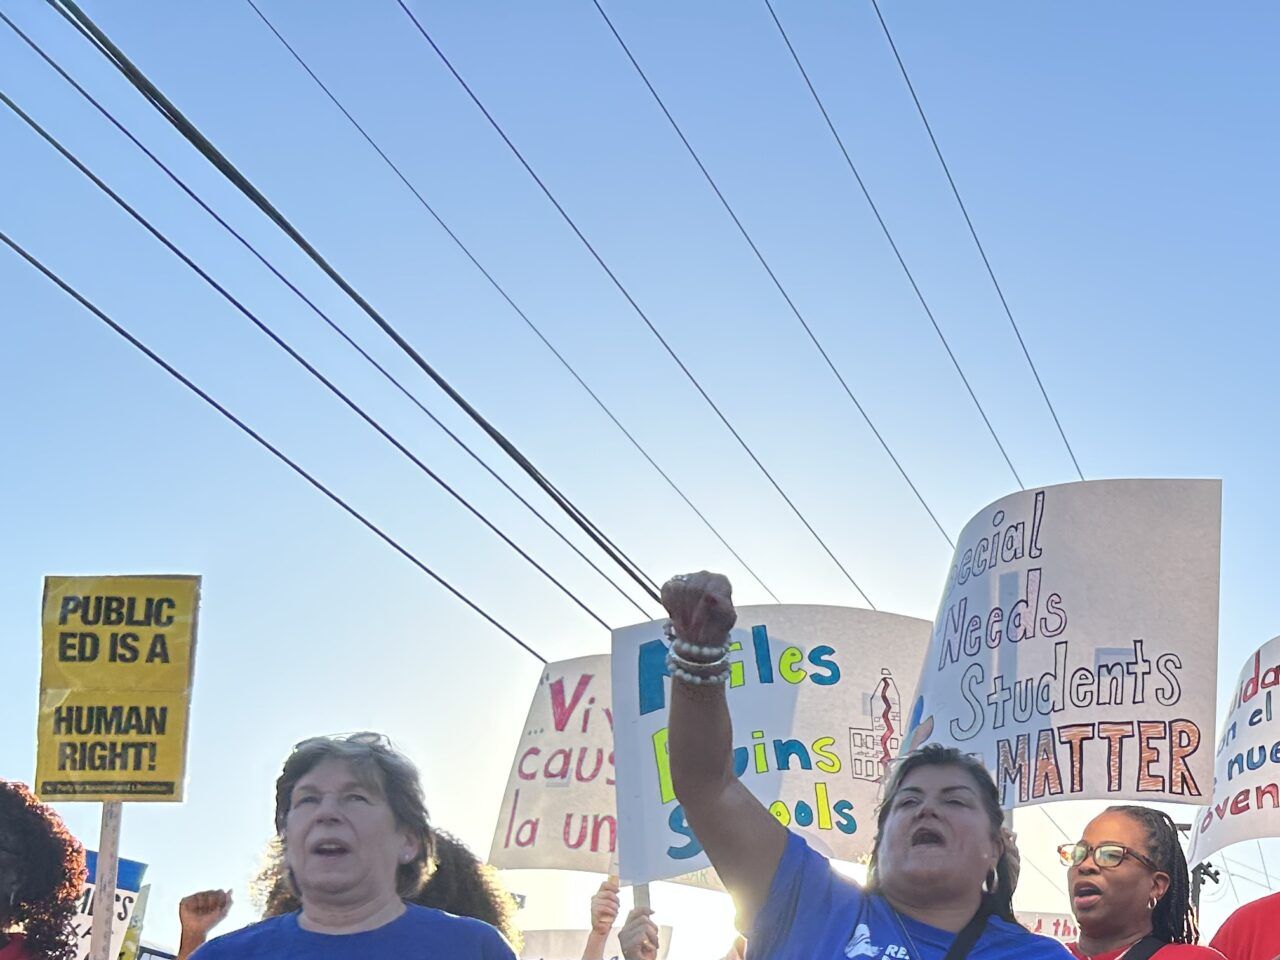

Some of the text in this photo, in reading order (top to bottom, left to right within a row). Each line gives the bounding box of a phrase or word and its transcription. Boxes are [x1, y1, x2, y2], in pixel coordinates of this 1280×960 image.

[956, 490, 1045, 586] ecial
[58, 595, 177, 627] PUBLIC
[938, 567, 1068, 671] Needs
[58, 631, 170, 664] ED IS A
[950, 639, 1183, 742] Students
[1249, 690, 1273, 727] el
[53, 705, 168, 736] HUMAN
[57, 741, 158, 772] RIGHT!
[997, 718, 1203, 806] MATTER
[503, 788, 541, 849] la
